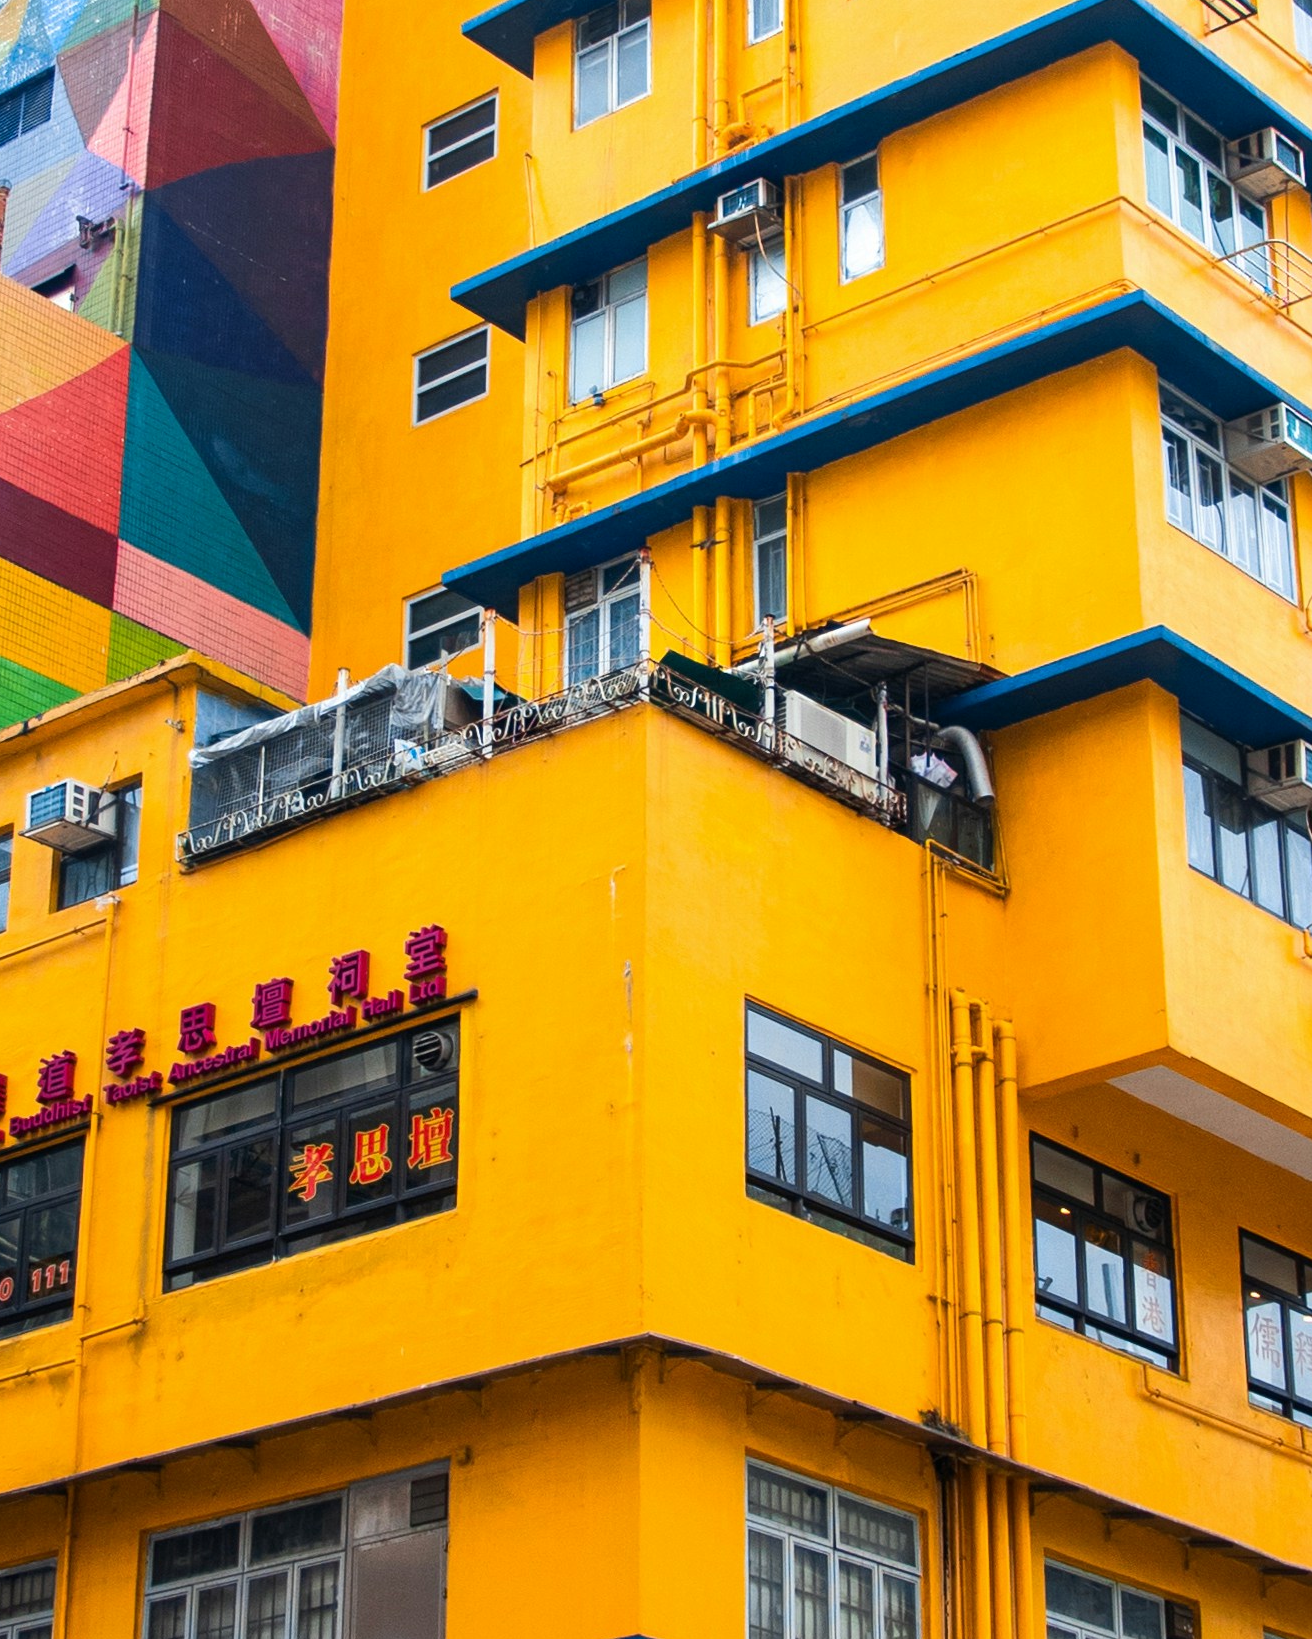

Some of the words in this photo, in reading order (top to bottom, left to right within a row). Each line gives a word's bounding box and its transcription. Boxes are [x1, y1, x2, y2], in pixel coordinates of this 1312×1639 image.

[9, 1094, 94, 1138] Buddhist
[103, 1071, 163, 1107] Taoist
[168, 1037, 261, 1085] Ancestral
[264, 1005, 357, 1053] Memorial
[362, 989, 404, 1022] Hall
[409, 976, 447, 1006] Ltd
[287, 1107, 454, 1202] 孝思壇
[32, 1260, 71, 1293] 111
